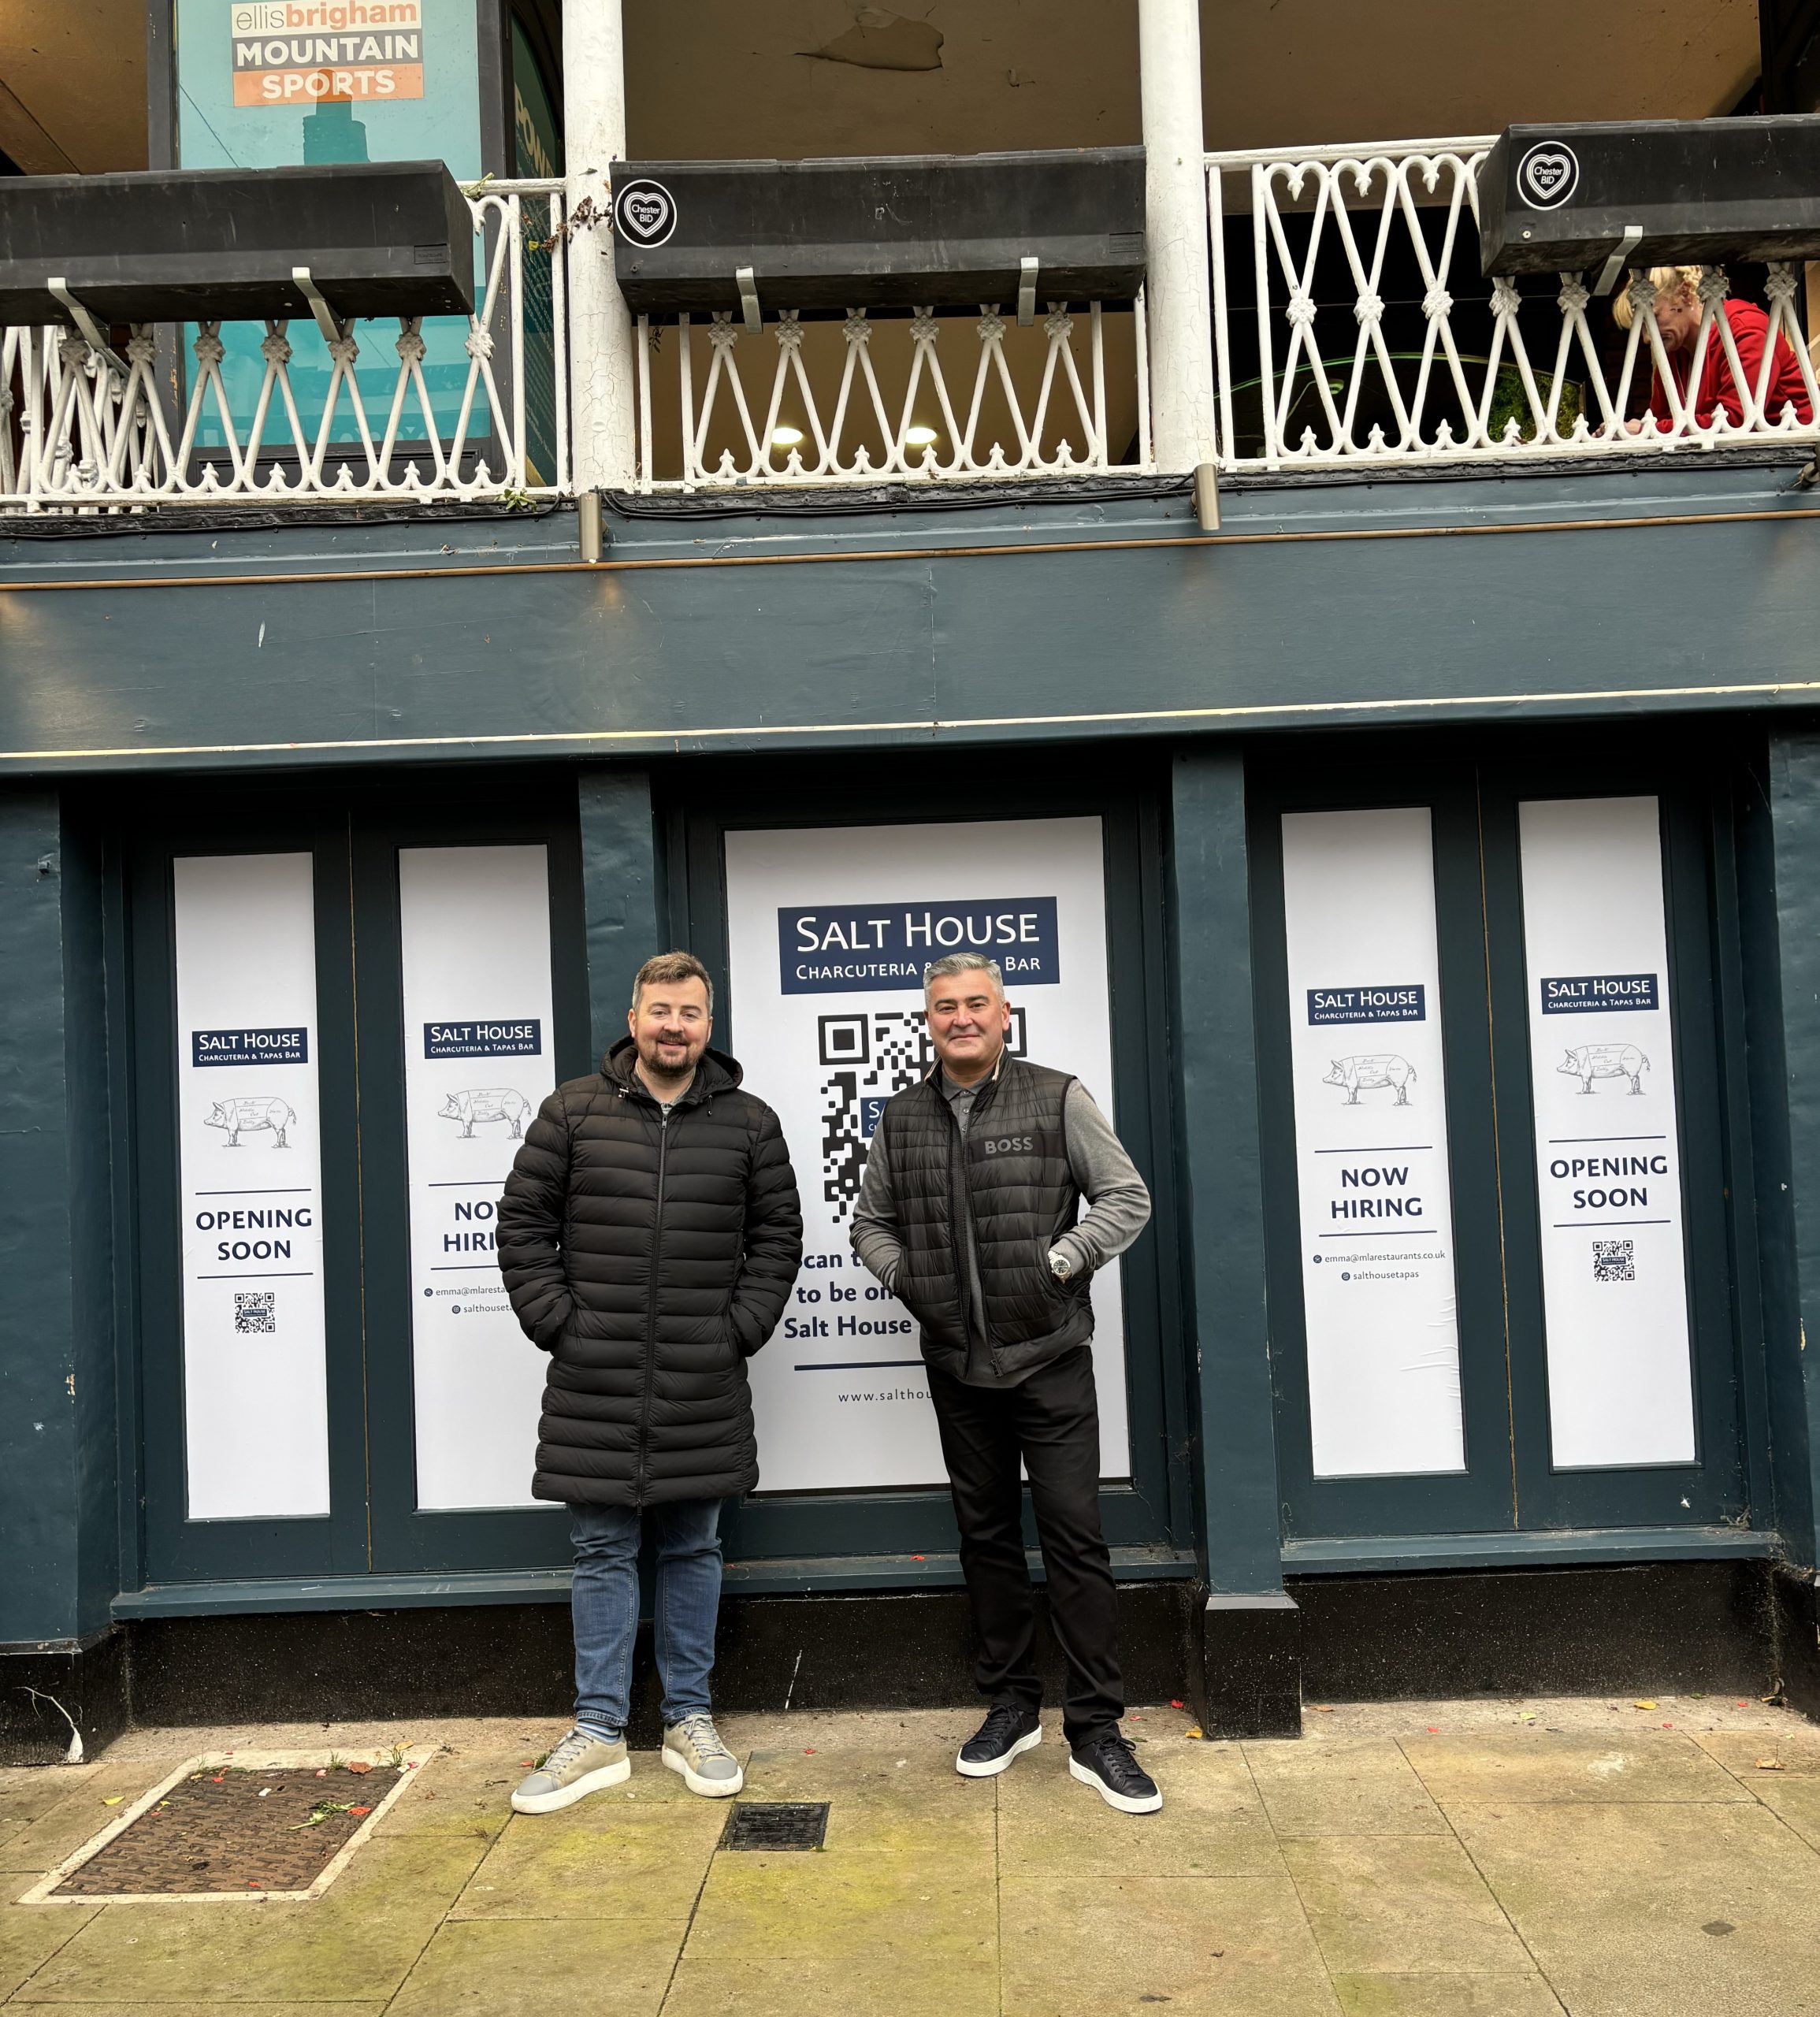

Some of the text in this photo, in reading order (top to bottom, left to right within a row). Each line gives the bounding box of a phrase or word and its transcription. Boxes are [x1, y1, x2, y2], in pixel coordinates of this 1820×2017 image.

[236, 0, 417, 31] ellisbrigham
[236, 35, 418, 66] MOUNTAIN
[262, 69, 396, 99] SPORTS
[1534, 166, 1563, 176] Chester
[1540, 176, 1555, 184] BID
[631, 204, 661, 214] Chester
[639, 214, 654, 222] BID
[796, 912, 1040, 952] SALT HOUSE
[796, 963, 918, 980] CHARCUTERIA
[1005, 956, 1041, 971] BAR
[1548, 979, 1651, 997] SALT HOUSE
[1314, 990, 1417, 1008] SALT HOUSE
[199, 1033, 300, 1050] SALT HOUSE
[431, 1025, 533, 1042] SALT HOUSE
[985, 1136, 1034, 1155] BOSS
[1550, 1155, 1668, 1179] OPENING
[1341, 1167, 1409, 1187] NOW
[1573, 1187, 1648, 1209] SOON
[455, 1201, 499, 1220] NO
[1331, 1197, 1423, 1219] HIRING
[195, 1209, 312, 1231] OPENING
[217, 1240, 292, 1261] SOON
[444, 1231, 495, 1252] HIRI
[799, 1254, 842, 1269] can
[1324, 1250, 1447, 1263] emma@mlarestaurants.co.uk
[1353, 1271, 1419, 1280] salthousetapas
[435, 1286, 507, 1296] emma@mlaresta
[797, 1287, 821, 1303] to
[830, 1281, 856, 1302] be
[784, 1315, 912, 1339] Salt House
[838, 1388, 932, 1402] www.salthou
